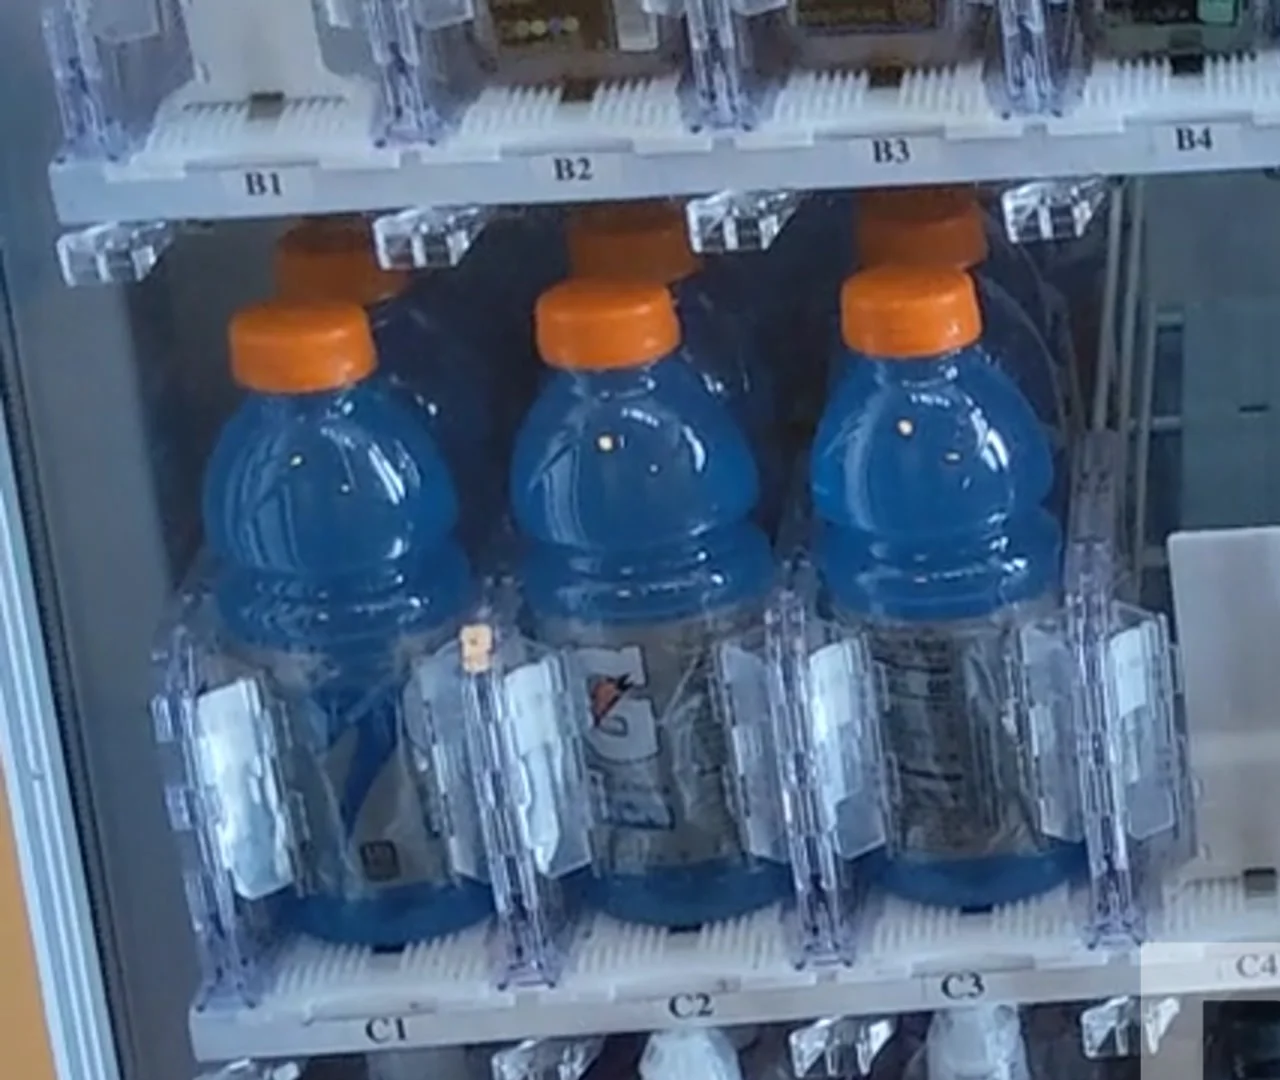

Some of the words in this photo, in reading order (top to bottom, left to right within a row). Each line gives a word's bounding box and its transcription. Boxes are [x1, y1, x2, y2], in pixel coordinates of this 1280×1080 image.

[1175, 127, 1213, 152] B4
[872, 140, 911, 165] B3
[553, 156, 594, 183] B2
[245, 171, 283, 196] B1
[1235, 952, 1279, 978] C4
[940, 973, 986, 1000] C3
[668, 993, 714, 1020] C2
[365, 1019, 408, 1043] C1
